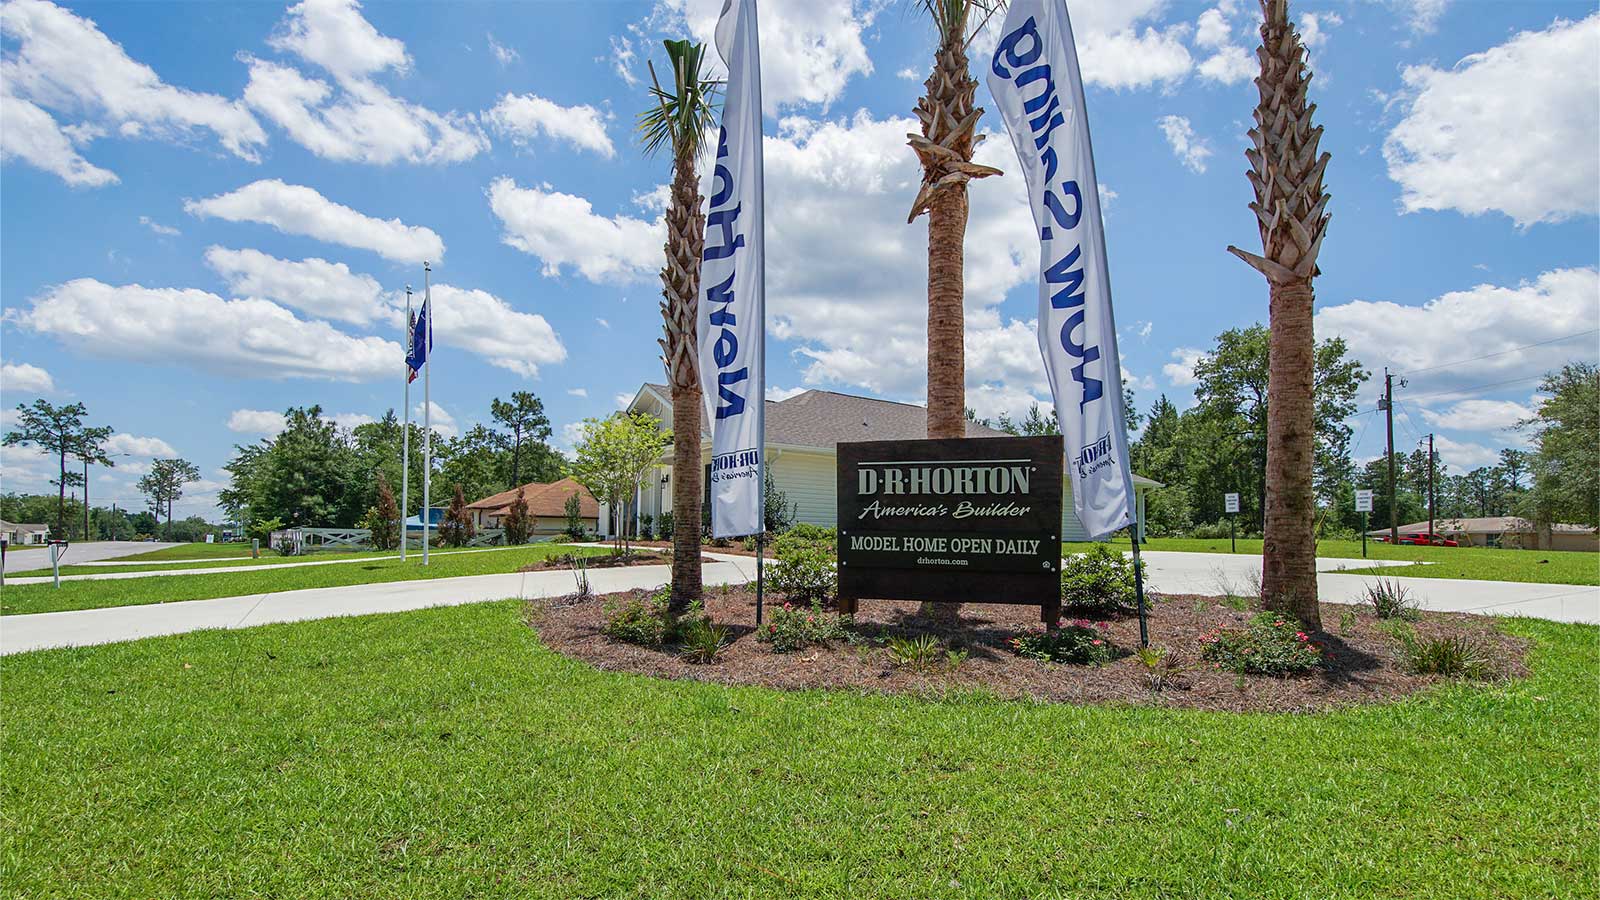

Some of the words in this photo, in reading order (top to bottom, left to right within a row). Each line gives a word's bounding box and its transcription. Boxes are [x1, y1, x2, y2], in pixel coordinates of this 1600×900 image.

[858, 500, 948, 520] America's
[952, 500, 1032, 520] Builder
[850, 535, 900, 552] MODEL
[903, 537, 947, 553] HOME
[951, 538, 992, 554] OPEN
[996, 539, 1041, 555] DAILY
[916, 556, 969, 567] drhorton.com
